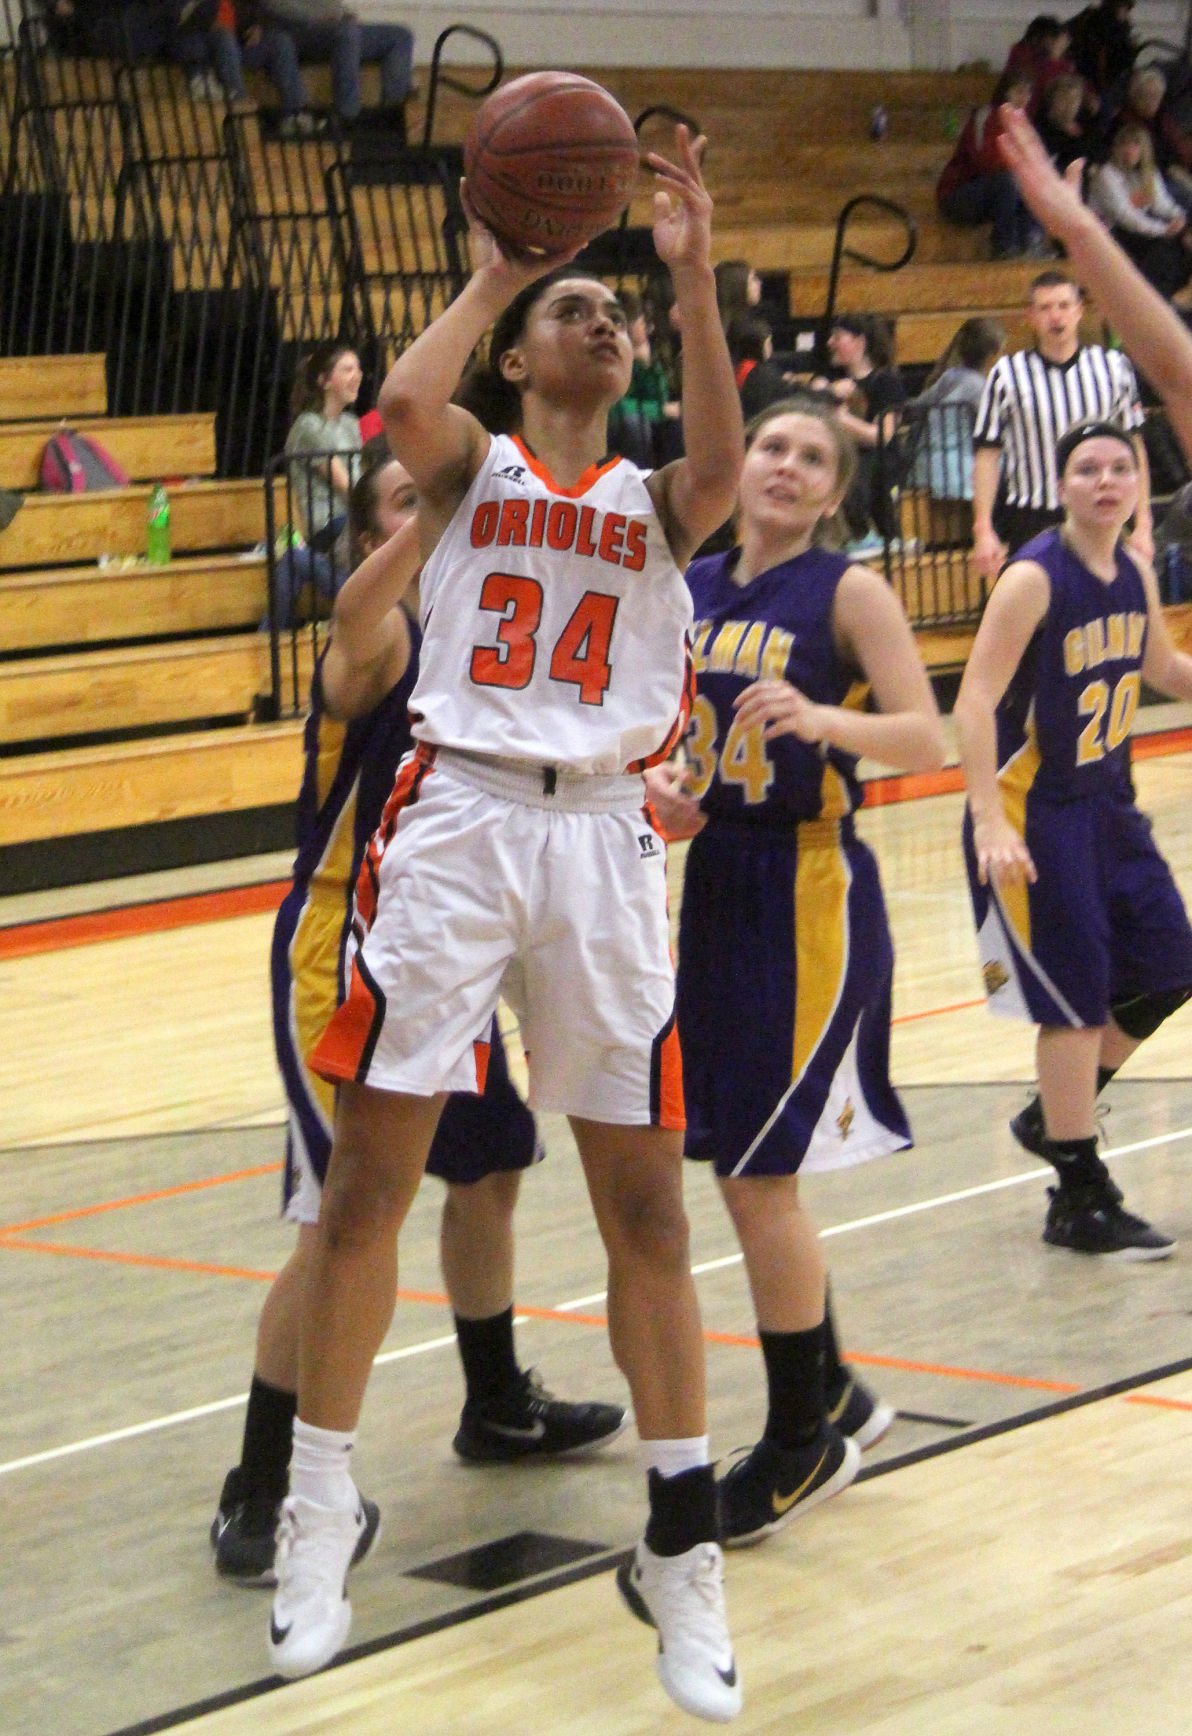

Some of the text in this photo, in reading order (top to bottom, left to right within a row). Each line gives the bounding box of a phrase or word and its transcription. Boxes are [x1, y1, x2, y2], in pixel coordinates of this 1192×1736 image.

[470, 499, 648, 572] ORIOLES
[469, 572, 620, 706] 34
[680, 693, 775, 804] 34
[1076, 669, 1142, 768] 20
